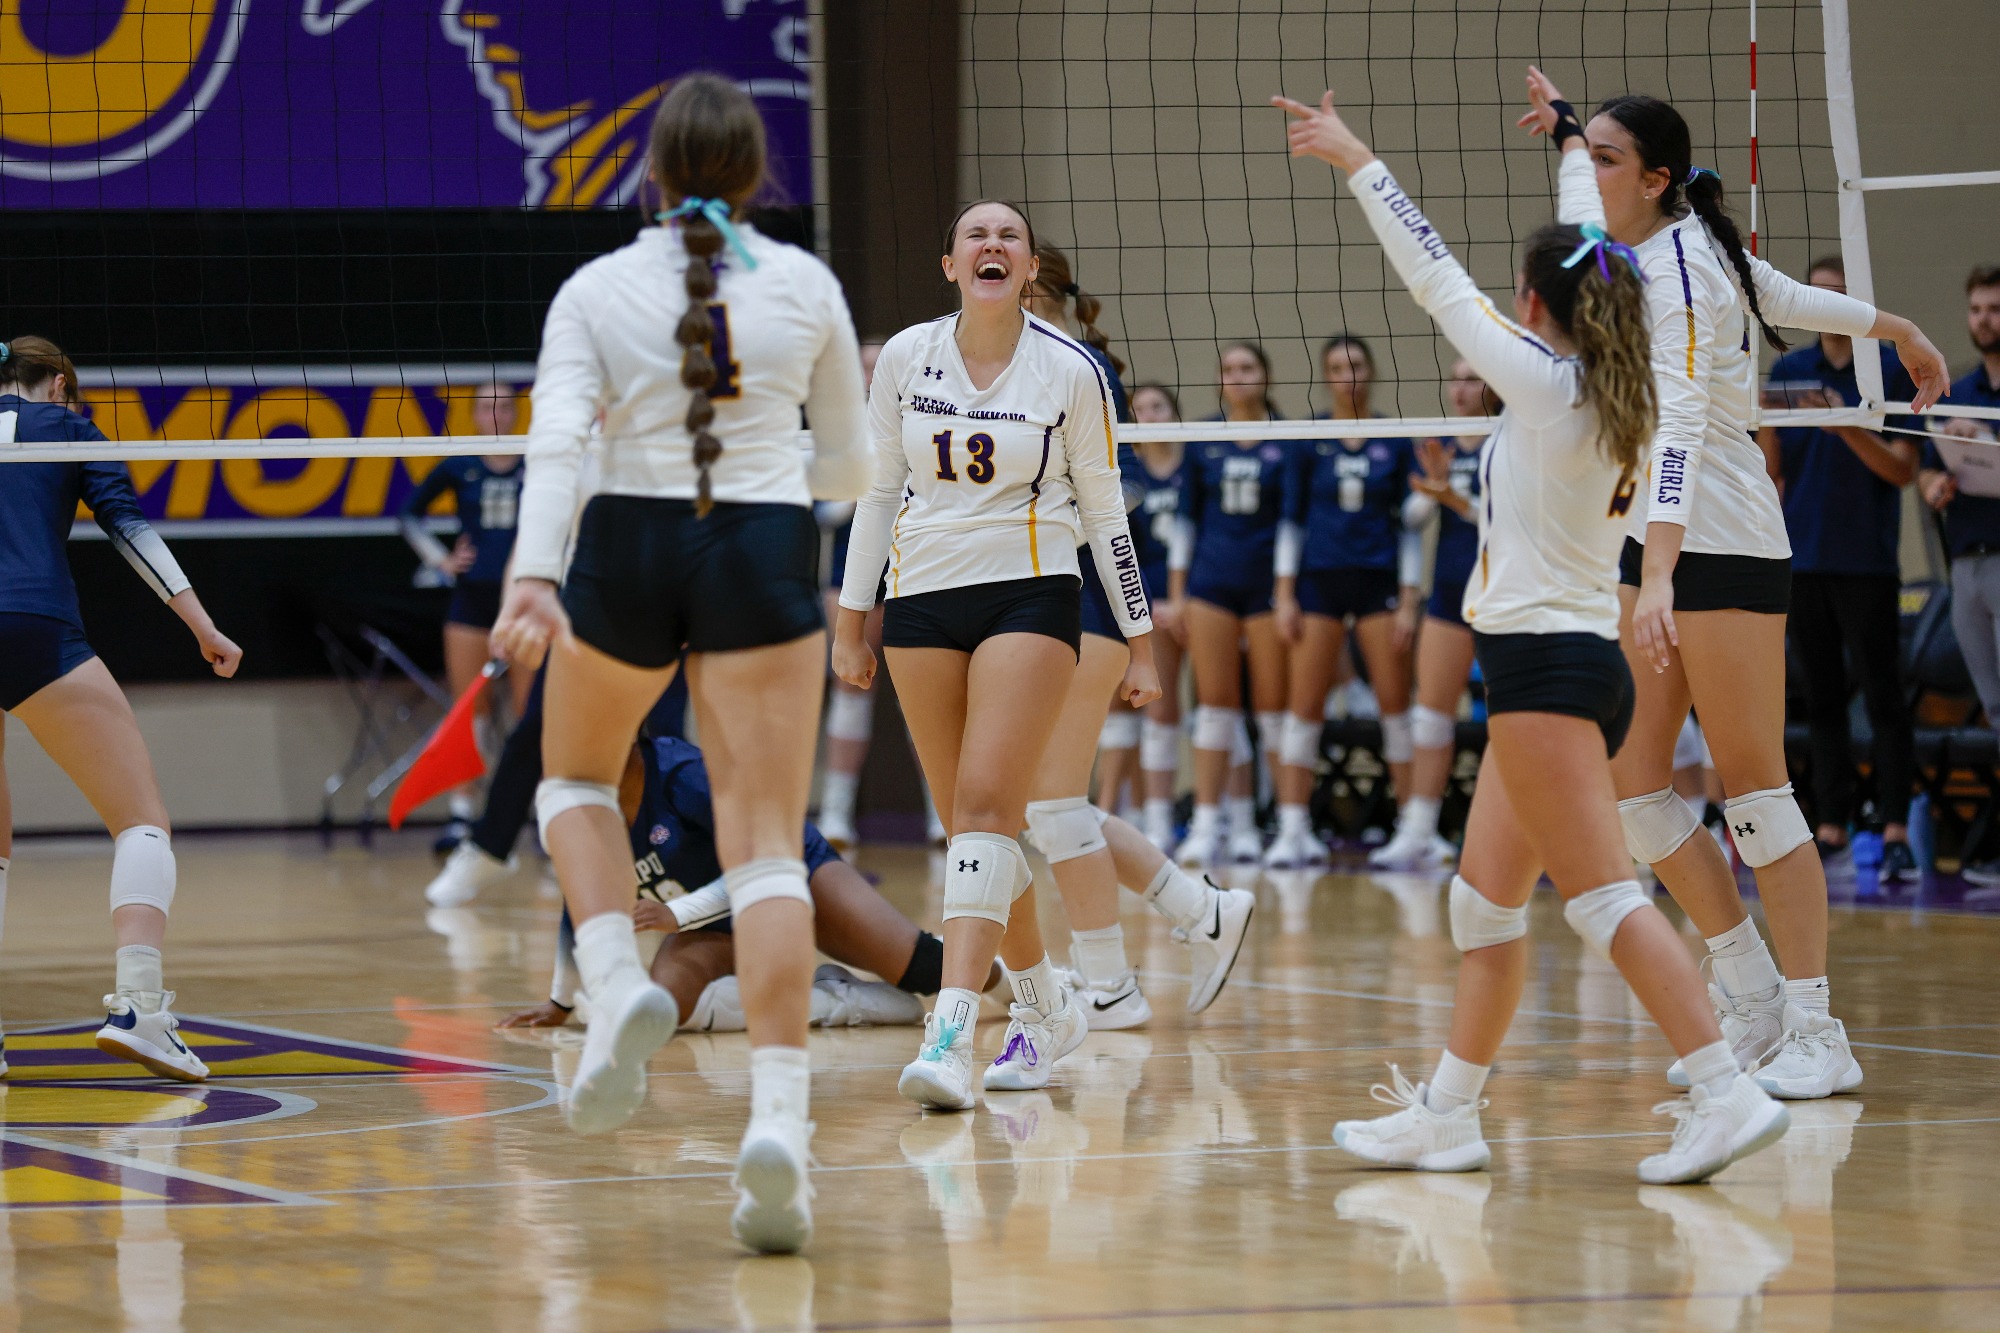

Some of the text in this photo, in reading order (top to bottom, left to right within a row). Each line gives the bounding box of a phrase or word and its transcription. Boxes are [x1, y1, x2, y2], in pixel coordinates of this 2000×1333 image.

[76, 387, 533, 520] MON
[932, 429, 996, 484] 13
[1111, 534, 1148, 621] COWGIRLS
[635, 851, 666, 884] PU
